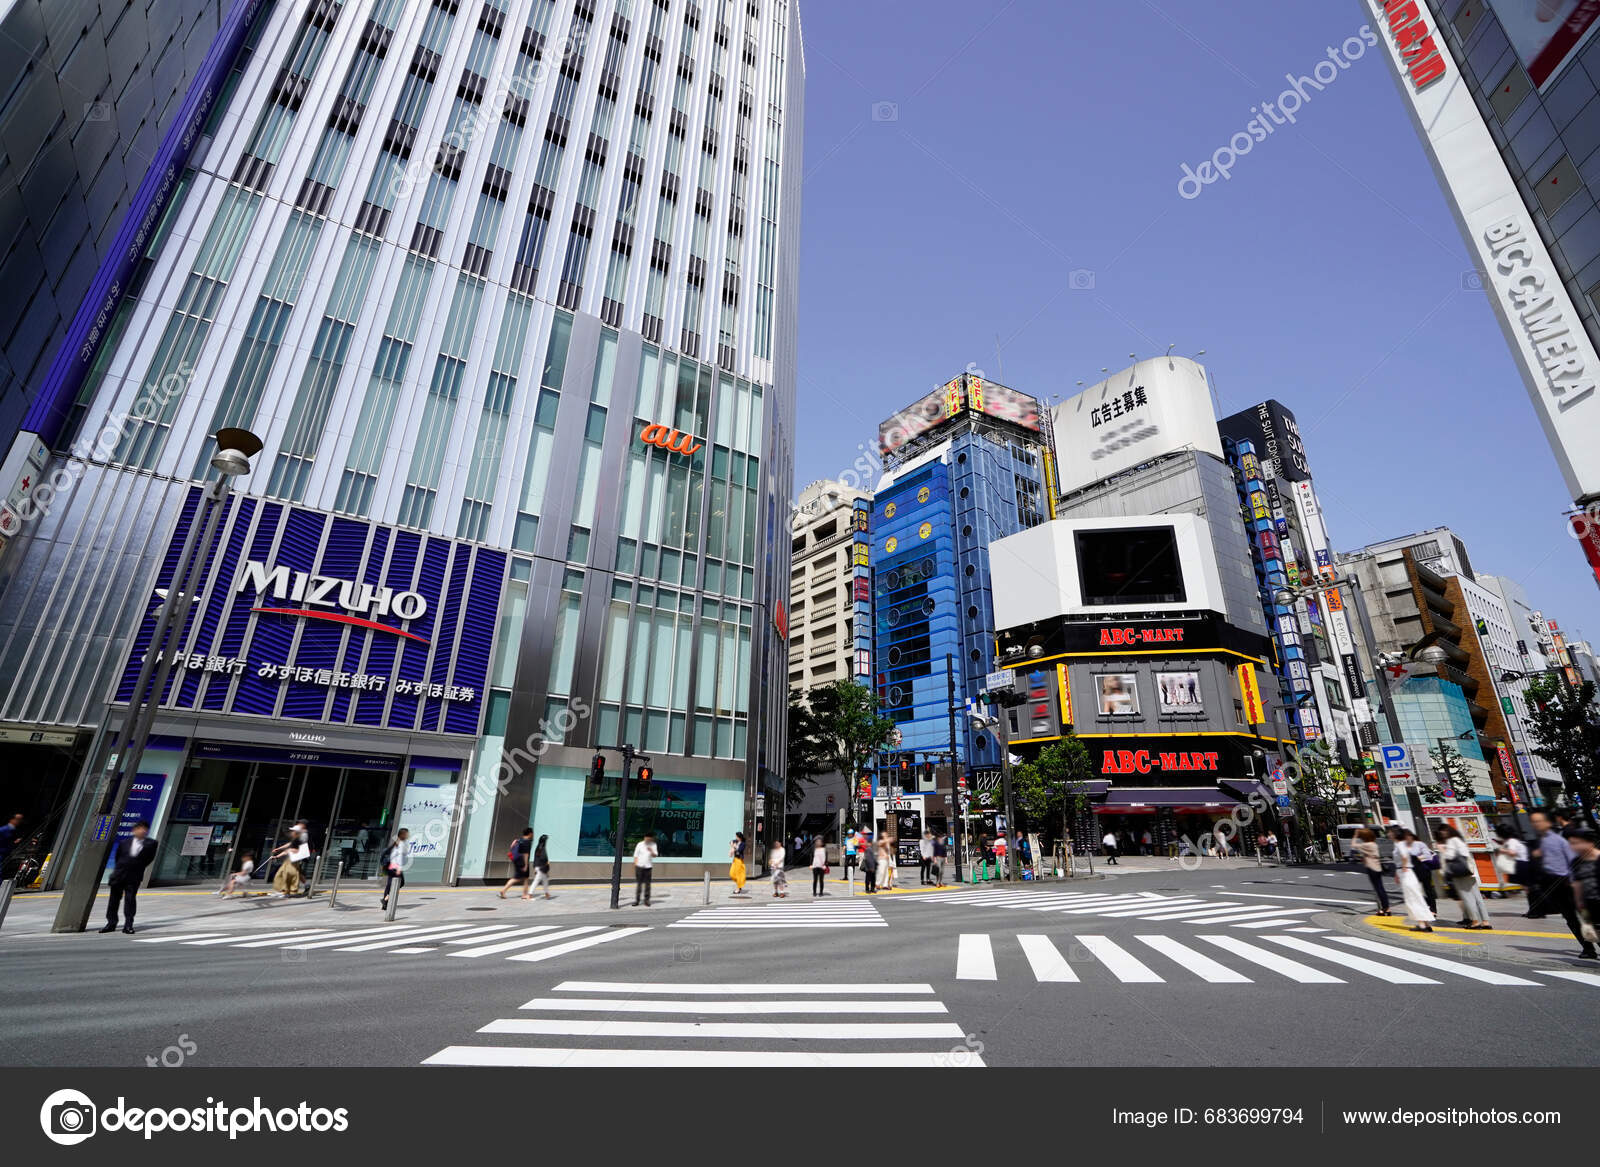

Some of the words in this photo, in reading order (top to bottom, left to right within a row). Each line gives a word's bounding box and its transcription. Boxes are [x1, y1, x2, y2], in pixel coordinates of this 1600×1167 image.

[1485, 214, 1533, 270] BIC
[1509, 268, 1596, 408] CAMERA
[1091, 386, 1147, 428] 広告主募集
[1257, 402, 1269, 420] THE
[640, 423, 702, 456] au
[1262, 420, 1274, 439] SUIT
[1267, 440, 1283, 478] COMPAN
[236, 560, 427, 620] MIZUHO
[1100, 628, 1184, 645] ABC-MART
[257, 661, 386, 692] みずほ信託銀行
[395, 678, 475, 703] みずほ証券
[288, 732, 326, 742] MIZUHO
[1101, 750, 1219, 774] ABC-MART
[1382, 746, 1405, 768] P
[660, 809, 703, 819] TORQUE
